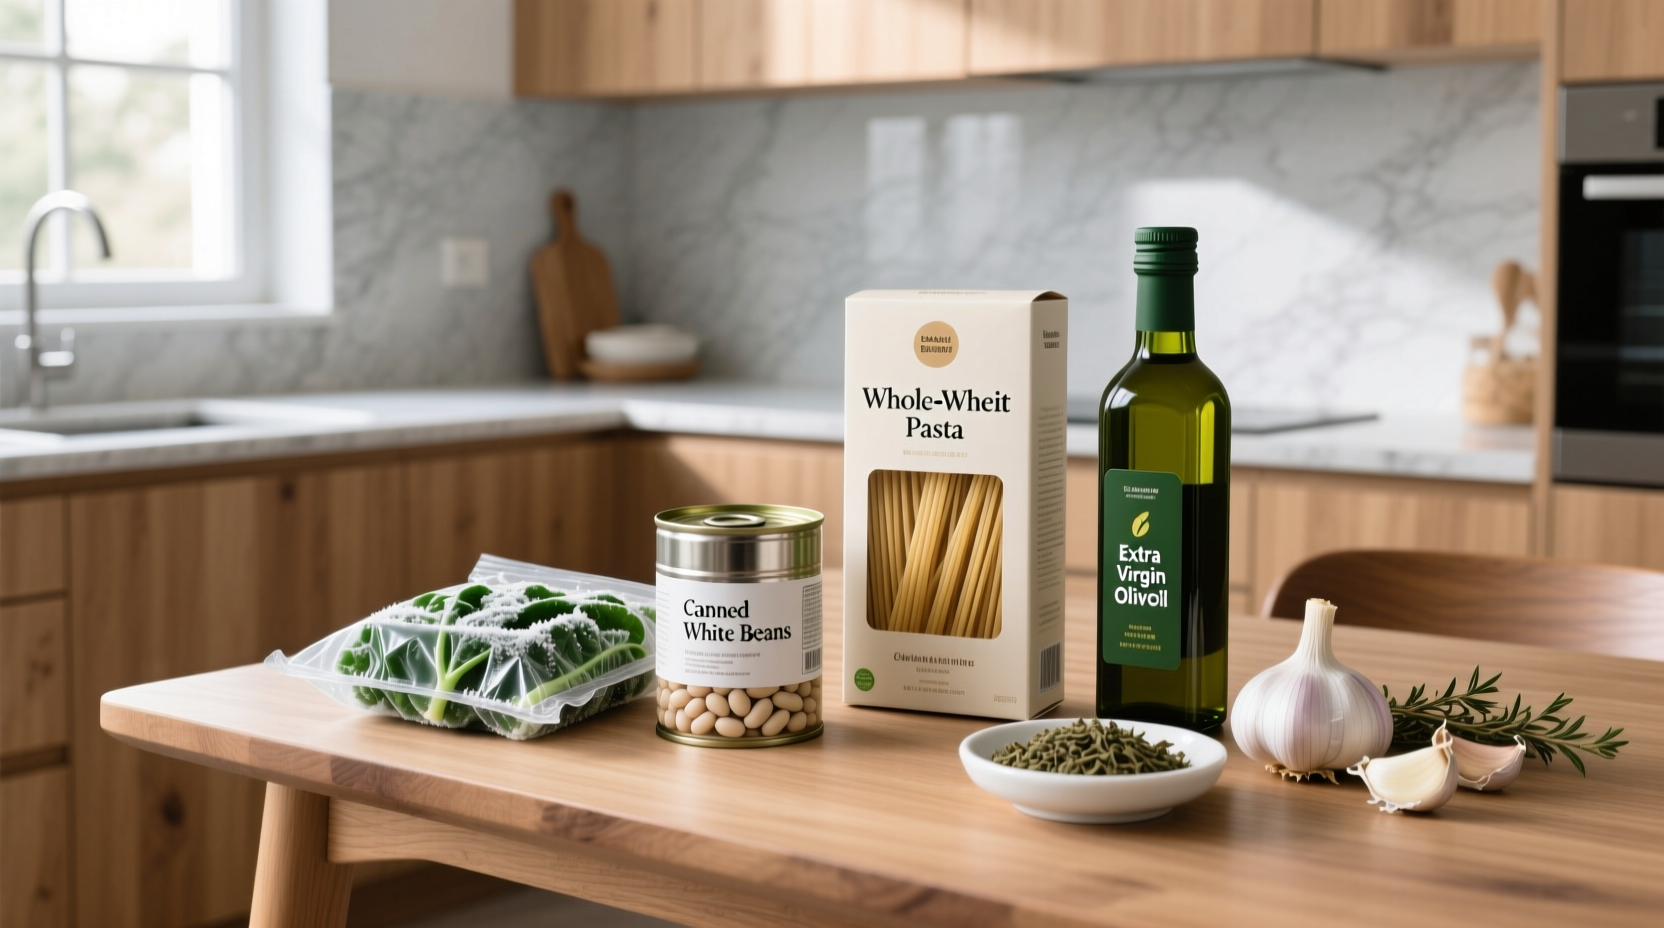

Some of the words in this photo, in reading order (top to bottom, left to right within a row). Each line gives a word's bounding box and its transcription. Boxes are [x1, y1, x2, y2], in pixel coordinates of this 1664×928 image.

[862, 386, 1011, 413] Whole-Wheit
[906, 416, 964, 440] Pasta
[1119, 543, 1161, 564] Extra
[1116, 564, 1166, 589] Virgin
[683, 599, 750, 619] Canned
[683, 621, 735, 642] White
[740, 623, 792, 642] Beans
